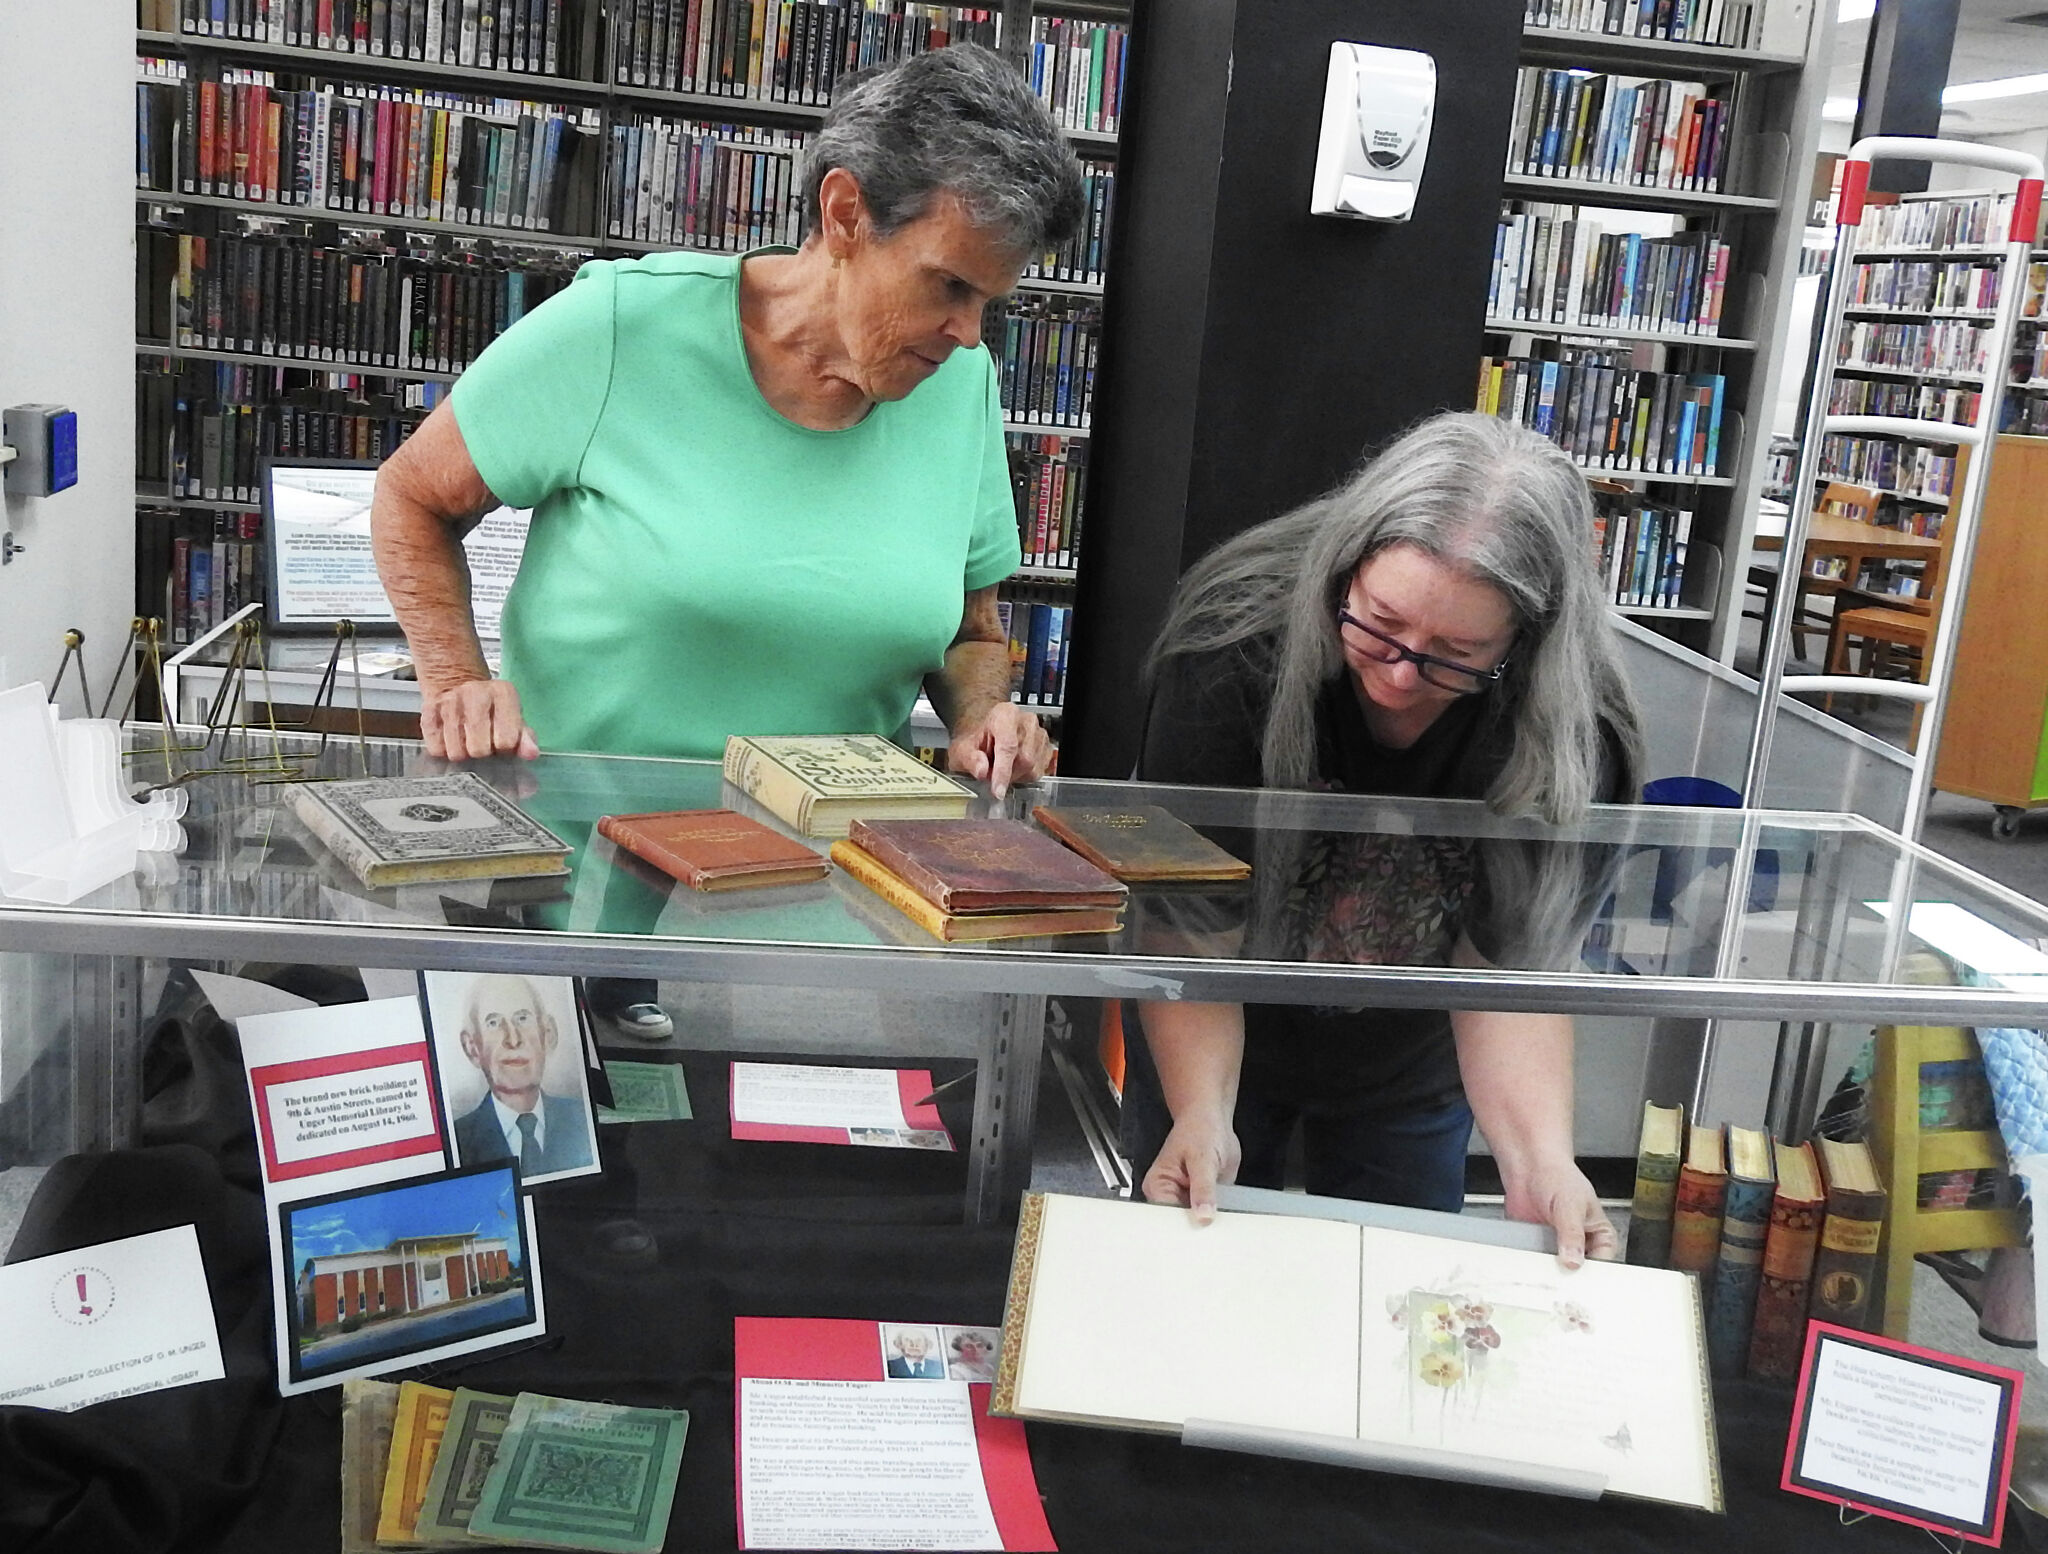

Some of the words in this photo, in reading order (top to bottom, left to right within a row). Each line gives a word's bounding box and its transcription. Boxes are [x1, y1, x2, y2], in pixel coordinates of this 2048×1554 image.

[808, 13, 818, 49] POWER
[414, 275, 427, 317] BLACK
[795, 760, 910, 777] Ship's
[812, 772, 939, 788] Company
[284, 1097, 301, 1107] The
[302, 1092, 329, 1104] brand
[330, 1091, 347, 1099] new
[349, 1085, 372, 1096] brick
[373, 1080, 408, 1093] building
[408, 1078, 418, 1086] at
[287, 1108, 302, 1118] 9th
[303, 1107, 312, 1116] &
[314, 1102, 342, 1114] Austin
[343, 1097, 374, 1110] Streets,
[375, 1092, 403, 1104] named
[404, 1090, 418, 1099] the
[296, 1128, 337, 1142] dedicated
[338, 1125, 350, 1134] on
[351, 1120, 380, 1133] August
[382, 1117, 396, 1127] 14,
[396, 1112, 418, 1124] 1960.
[299, 1119, 326, 1129] Unger
[327, 1109, 369, 1122] Memorial
[370, 1104, 402, 1116] Library
[403, 1102, 412, 1110] is
[0, 1383, 46, 1400] PERSONAL
[49, 1373, 84, 1388] LIBRARY
[87, 1358, 142, 1378] COLLECTION
[142, 1353, 154, 1364] OF
[71, 1398, 87, 1411] THE
[121, 1380, 163, 1397] MEMORIAL
[166, 1370, 200, 1385] LIBRARY
